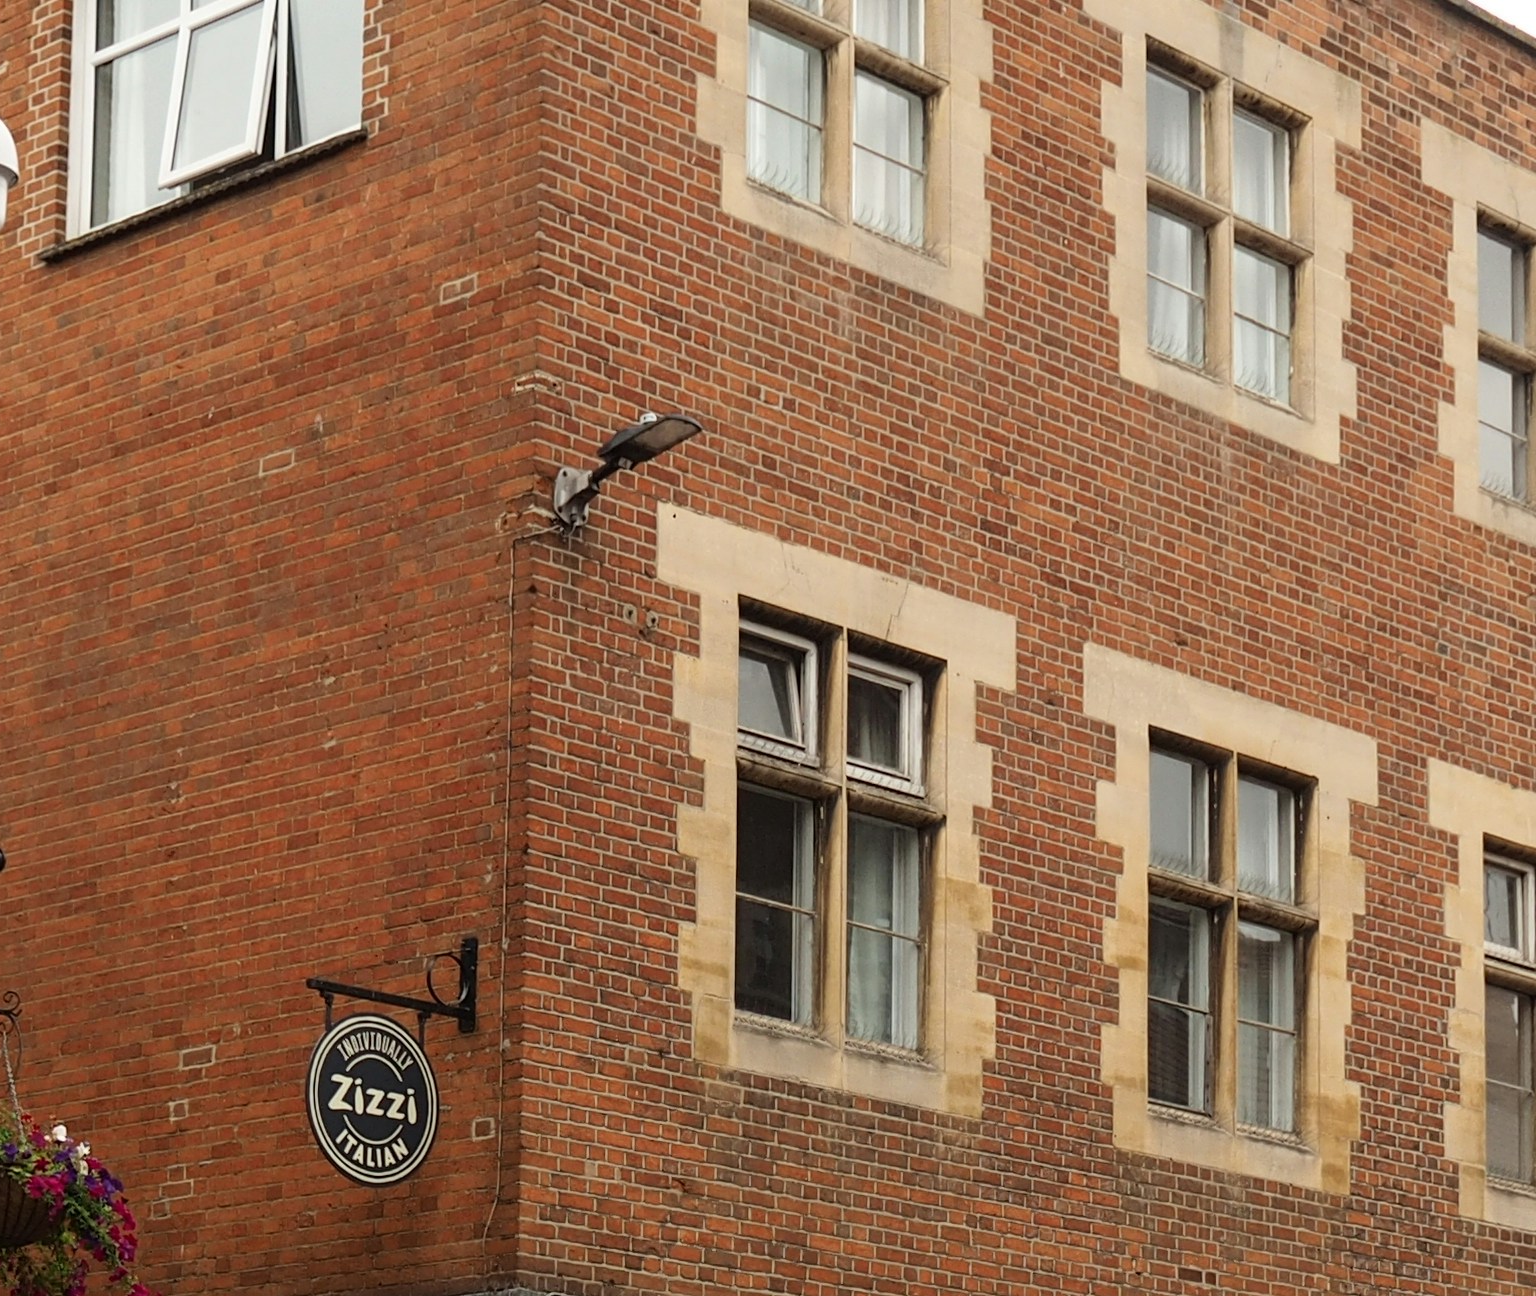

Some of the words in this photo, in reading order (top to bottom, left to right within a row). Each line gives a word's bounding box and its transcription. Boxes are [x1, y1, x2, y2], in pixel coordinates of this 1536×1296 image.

[336, 1031, 414, 1071] INDIVIDUALLY
[328, 1073, 418, 1125] Zizzi
[335, 1128, 409, 1168] ITALIAN
